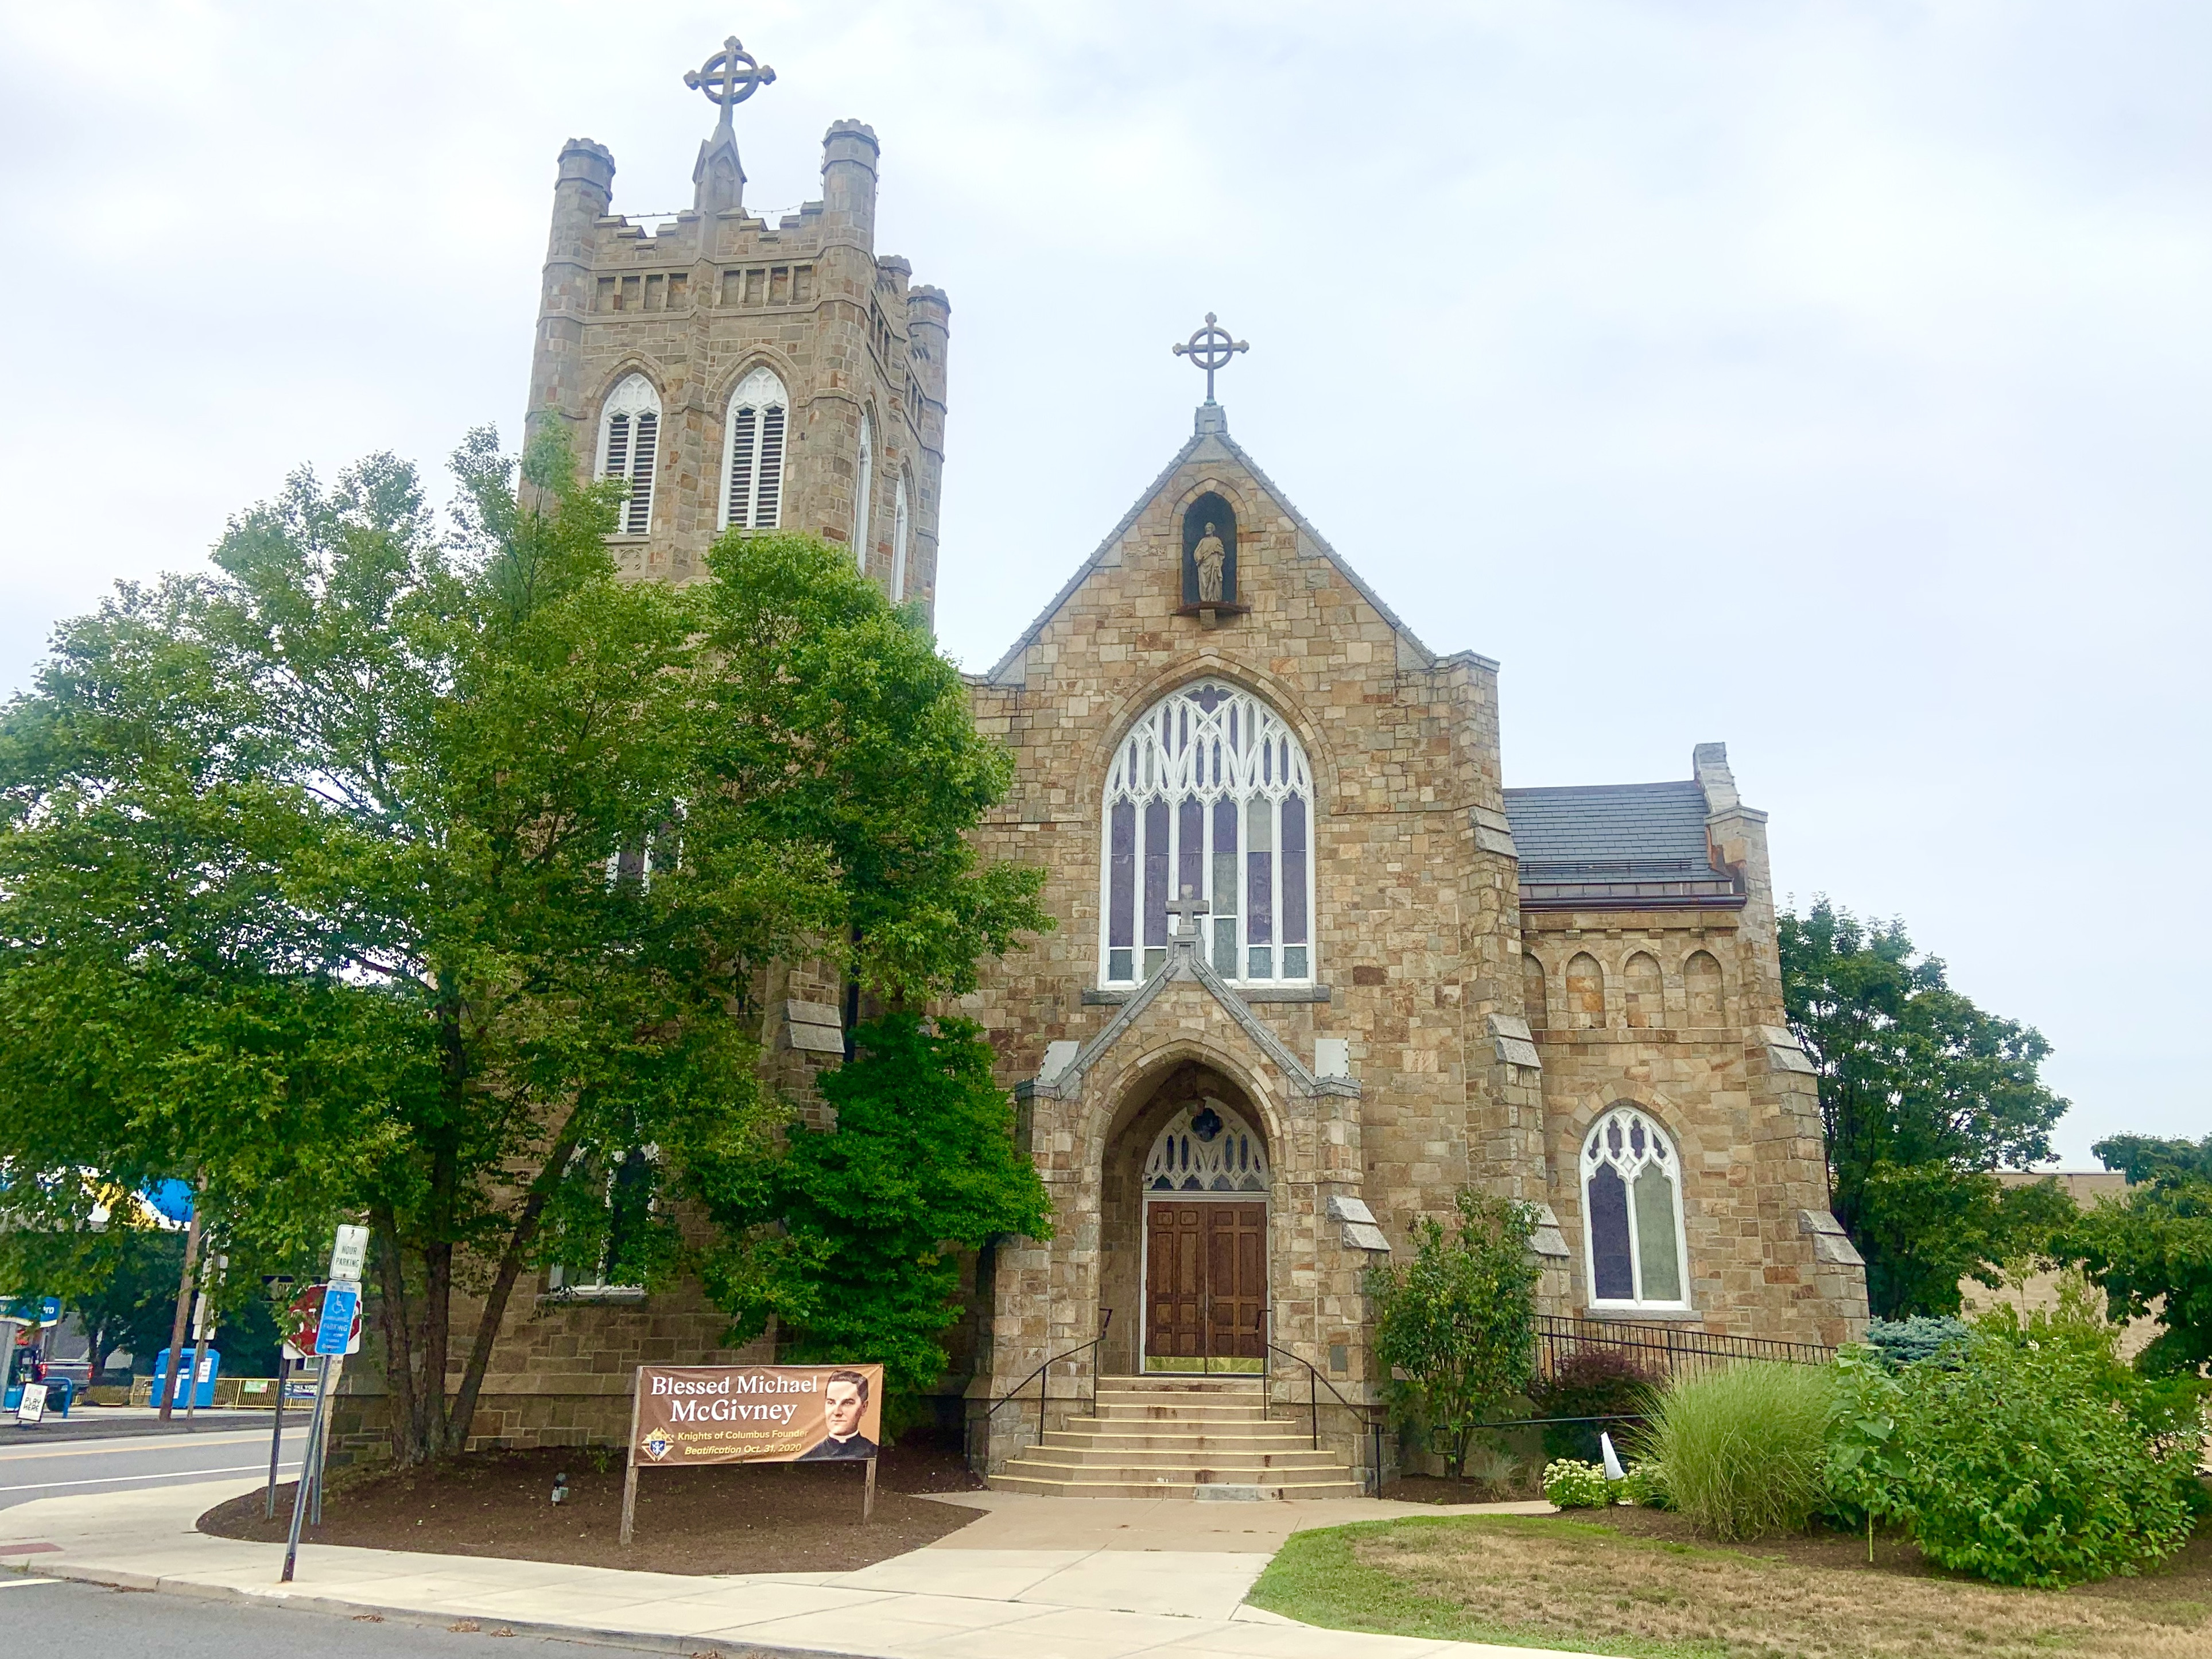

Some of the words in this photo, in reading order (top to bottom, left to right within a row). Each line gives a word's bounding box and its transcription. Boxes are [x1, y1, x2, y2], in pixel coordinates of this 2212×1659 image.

[341, 1246, 358, 1255] HOUR
[335, 1257, 360, 1267] PARKING
[651, 1376, 730, 1396] Blessed
[736, 1375, 818, 1393] Michael
[669, 1398, 798, 1425] McGivney
[678, 1432, 712, 1441] Knights
[715, 1431, 724, 1439] of
[725, 1430, 770, 1439] Columbus
[772, 1429, 809, 1438] Founder
[684, 1445, 742, 1455] Beatification
[744, 1444, 762, 1453] Oct.
[764, 1444, 775, 1453] 31,
[778, 1443, 802, 1452] 2020
